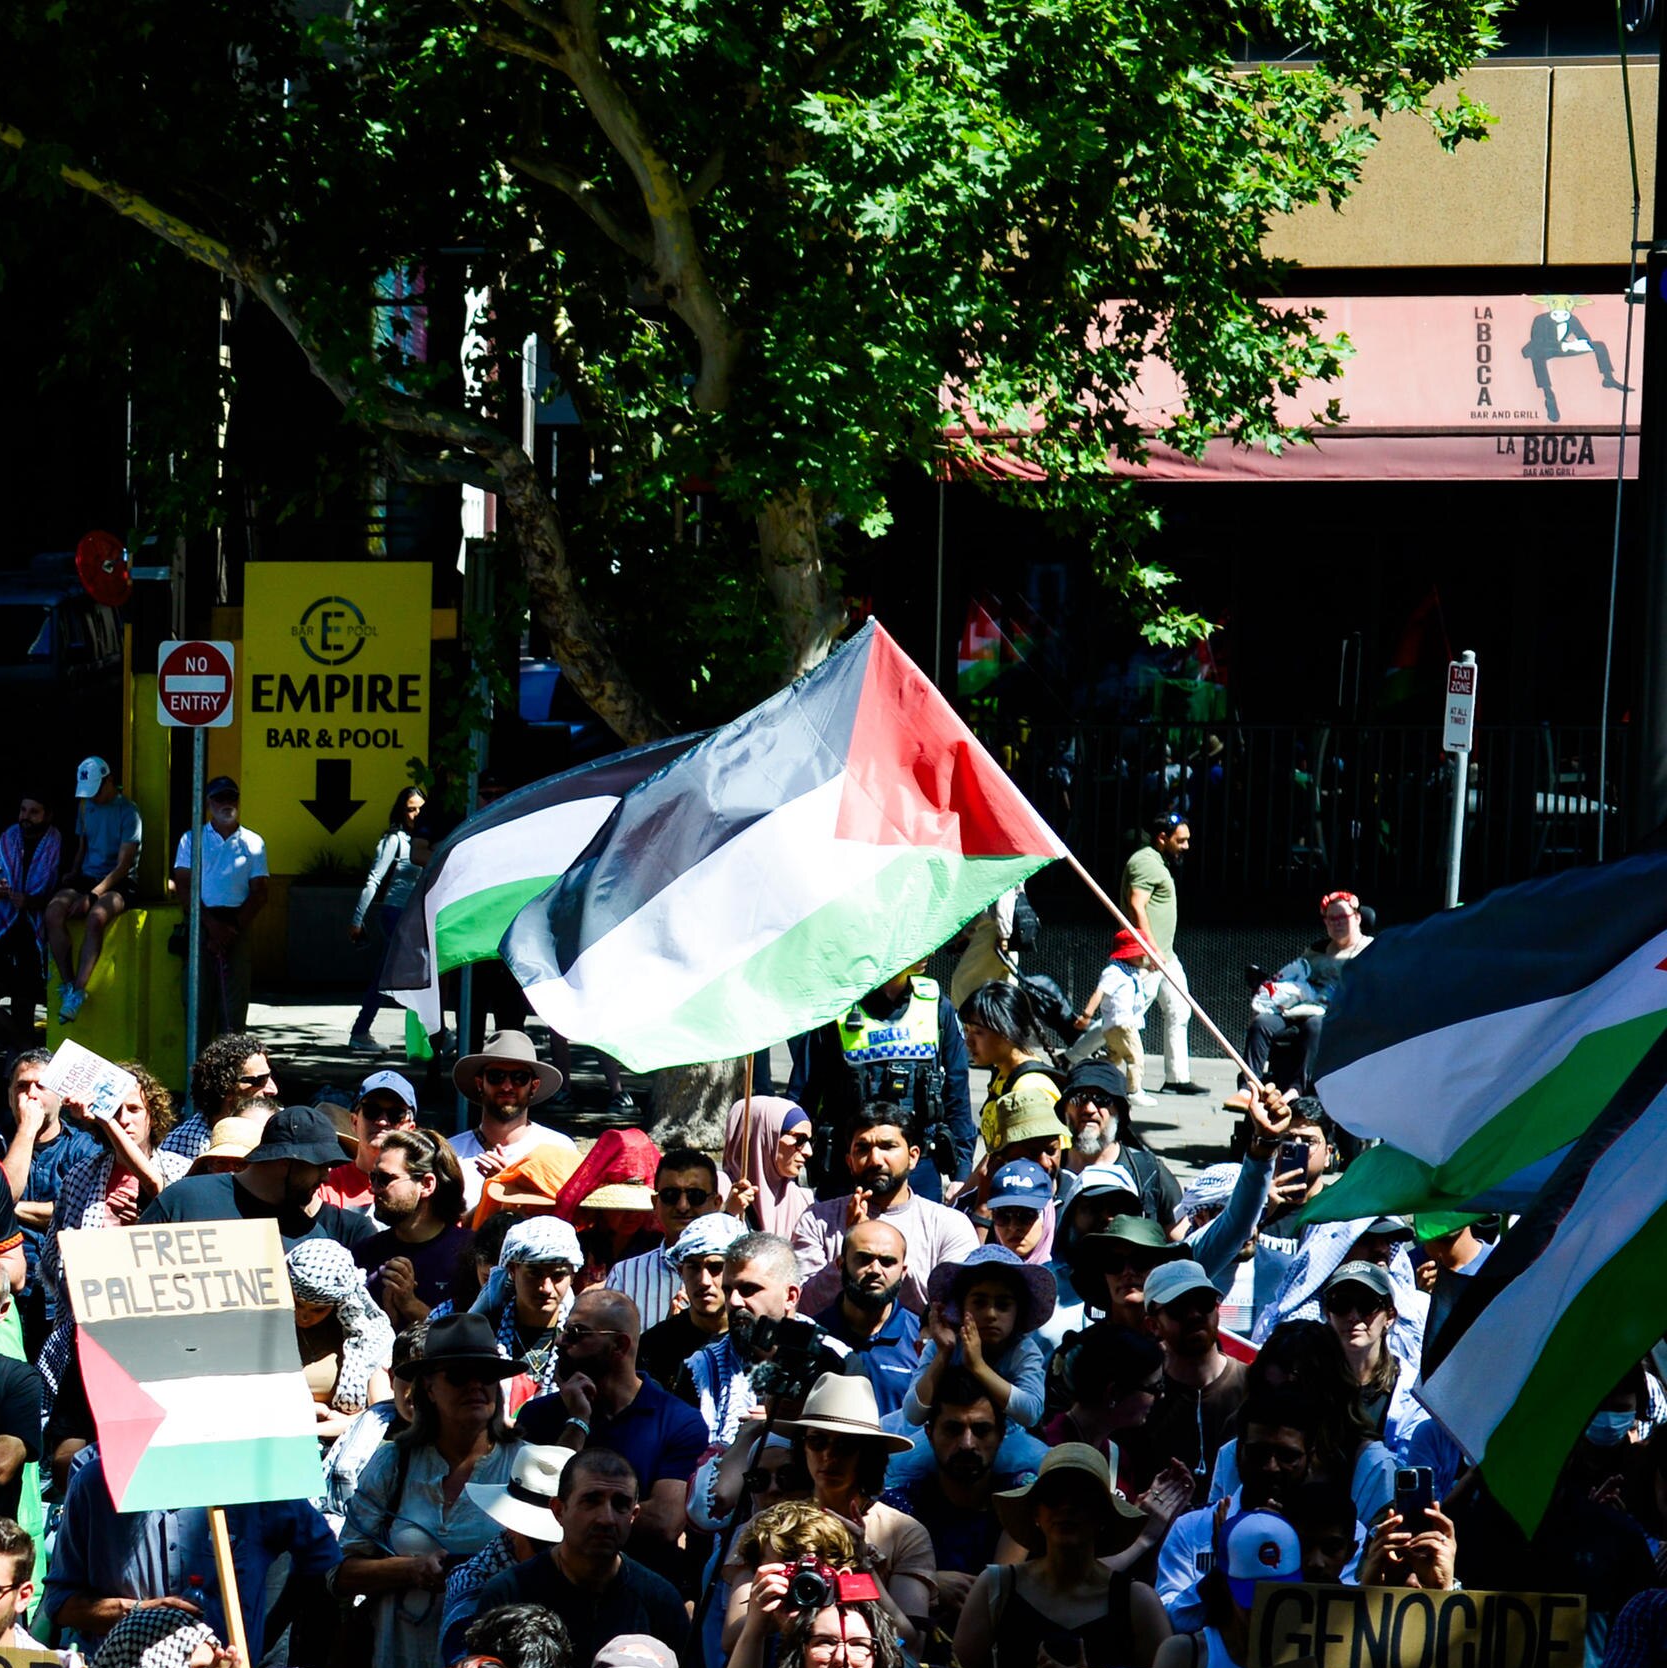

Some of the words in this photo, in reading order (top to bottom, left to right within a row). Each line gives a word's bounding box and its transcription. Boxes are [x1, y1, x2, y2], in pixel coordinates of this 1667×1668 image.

[1474, 306, 1493, 319] LA
[1477, 322, 1492, 406] BOCA
[1470, 411, 1488, 419] BAR
[1492, 411, 1511, 420] AND
[1514, 411, 1539, 420] GRILL
[1497, 437, 1515, 454] LA
[1523, 436, 1595, 465] BOCA
[292, 626, 313, 636] BAR
[348, 626, 379, 636] POOL
[186, 656, 208, 673] NO
[1453, 669, 1470, 681] TAXI
[252, 674, 421, 713] EMPIRE
[1451, 681, 1471, 693] ZONE
[171, 695, 220, 711] ENTRY
[267, 729, 311, 748] BAR
[316, 729, 334, 748] &
[339, 729, 404, 749] POOL
[1003, 1175, 1034, 1188] FILA
[129, 1229, 222, 1269] FREE
[81, 1267, 280, 1318] PALESTINE
